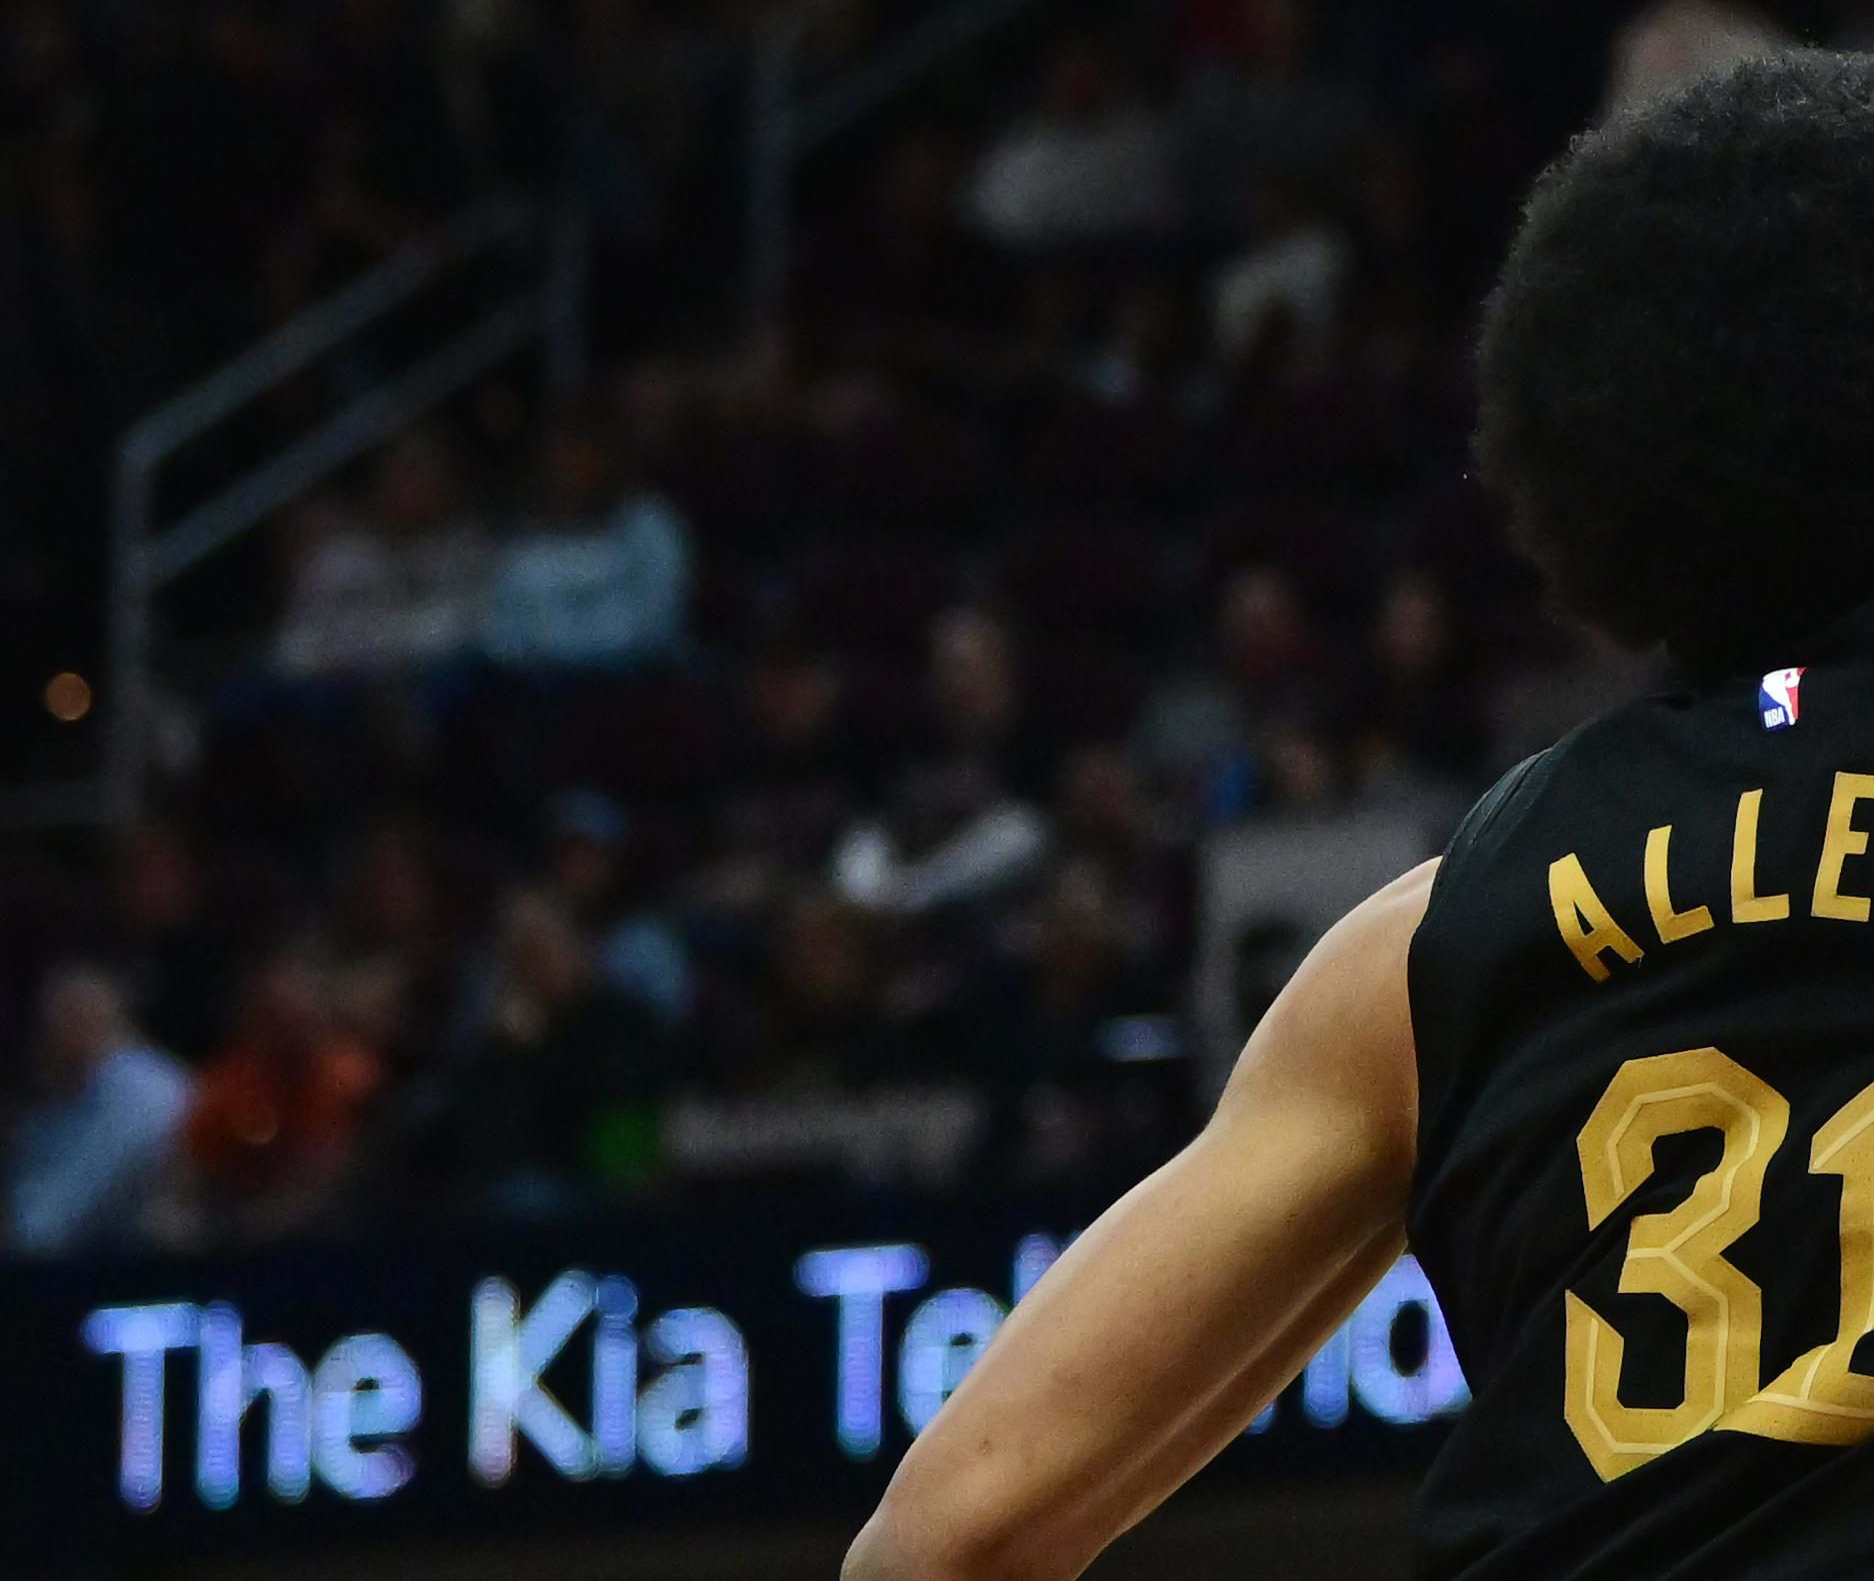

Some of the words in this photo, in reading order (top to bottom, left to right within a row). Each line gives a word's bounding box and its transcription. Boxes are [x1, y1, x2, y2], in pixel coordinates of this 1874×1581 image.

[1763, 706, 1786, 729] NBA
[82, 1300, 422, 1513] The
[467, 1269, 750, 1488] Kia
